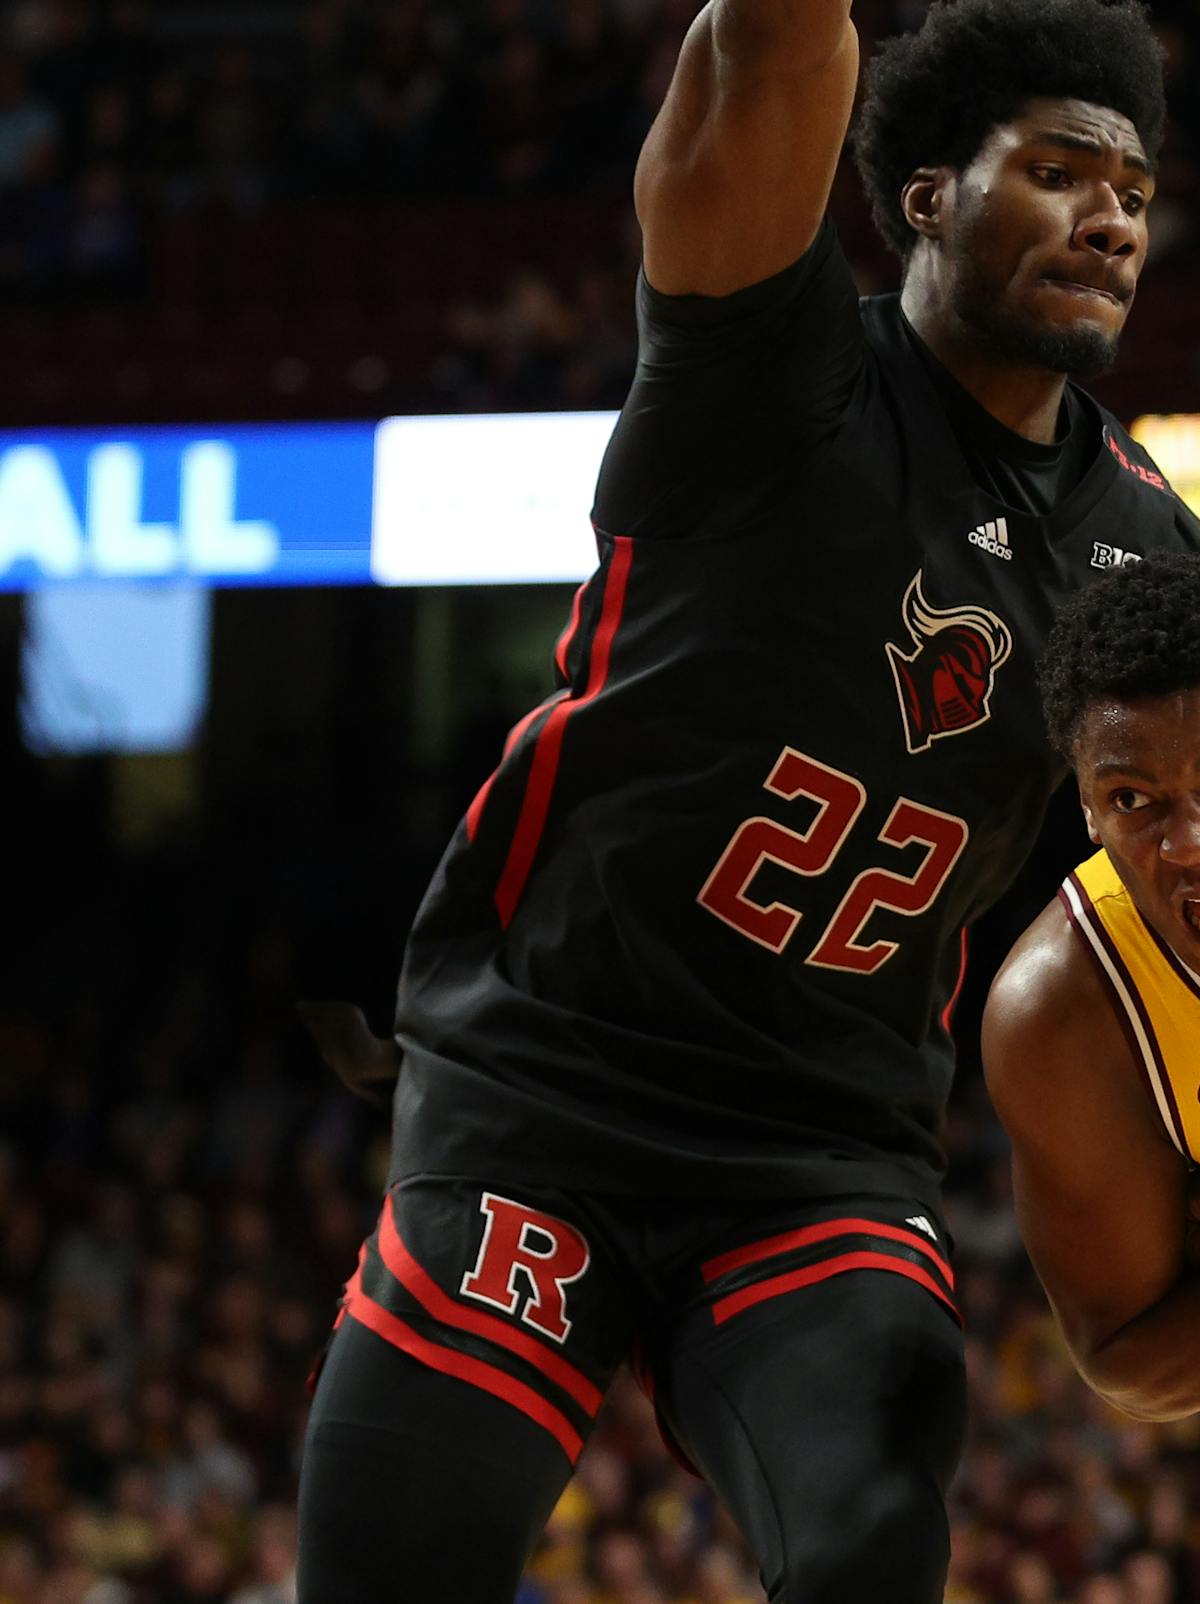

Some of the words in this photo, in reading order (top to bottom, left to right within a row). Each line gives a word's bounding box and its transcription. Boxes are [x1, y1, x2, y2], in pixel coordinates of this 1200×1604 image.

[967, 530, 1014, 562] adidas
[695, 745, 970, 975] 22
[459, 1191, 590, 1345] R
